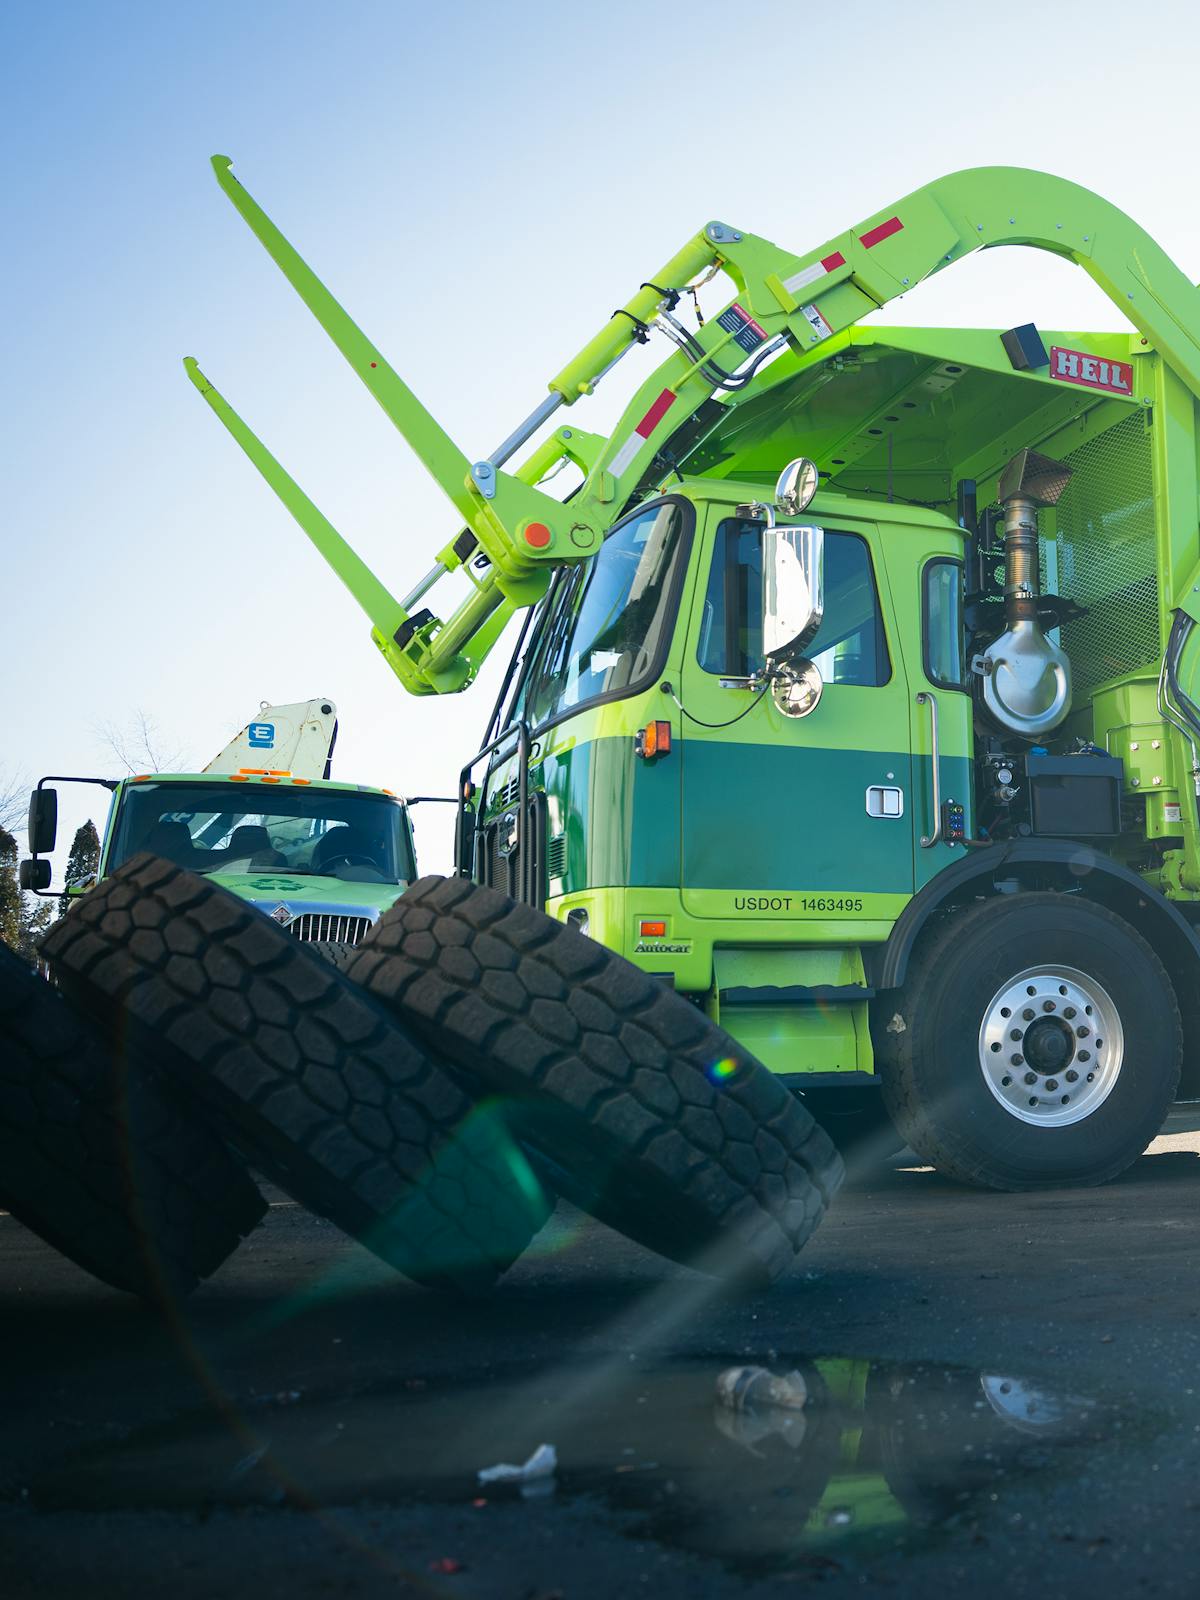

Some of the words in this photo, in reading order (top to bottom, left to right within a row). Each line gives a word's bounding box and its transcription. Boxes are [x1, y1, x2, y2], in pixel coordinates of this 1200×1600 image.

[1057, 352, 1128, 389] HEIL
[734, 897, 792, 912] USDOT
[801, 898, 863, 912] 1463495
[633, 940, 691, 954] Autocar
